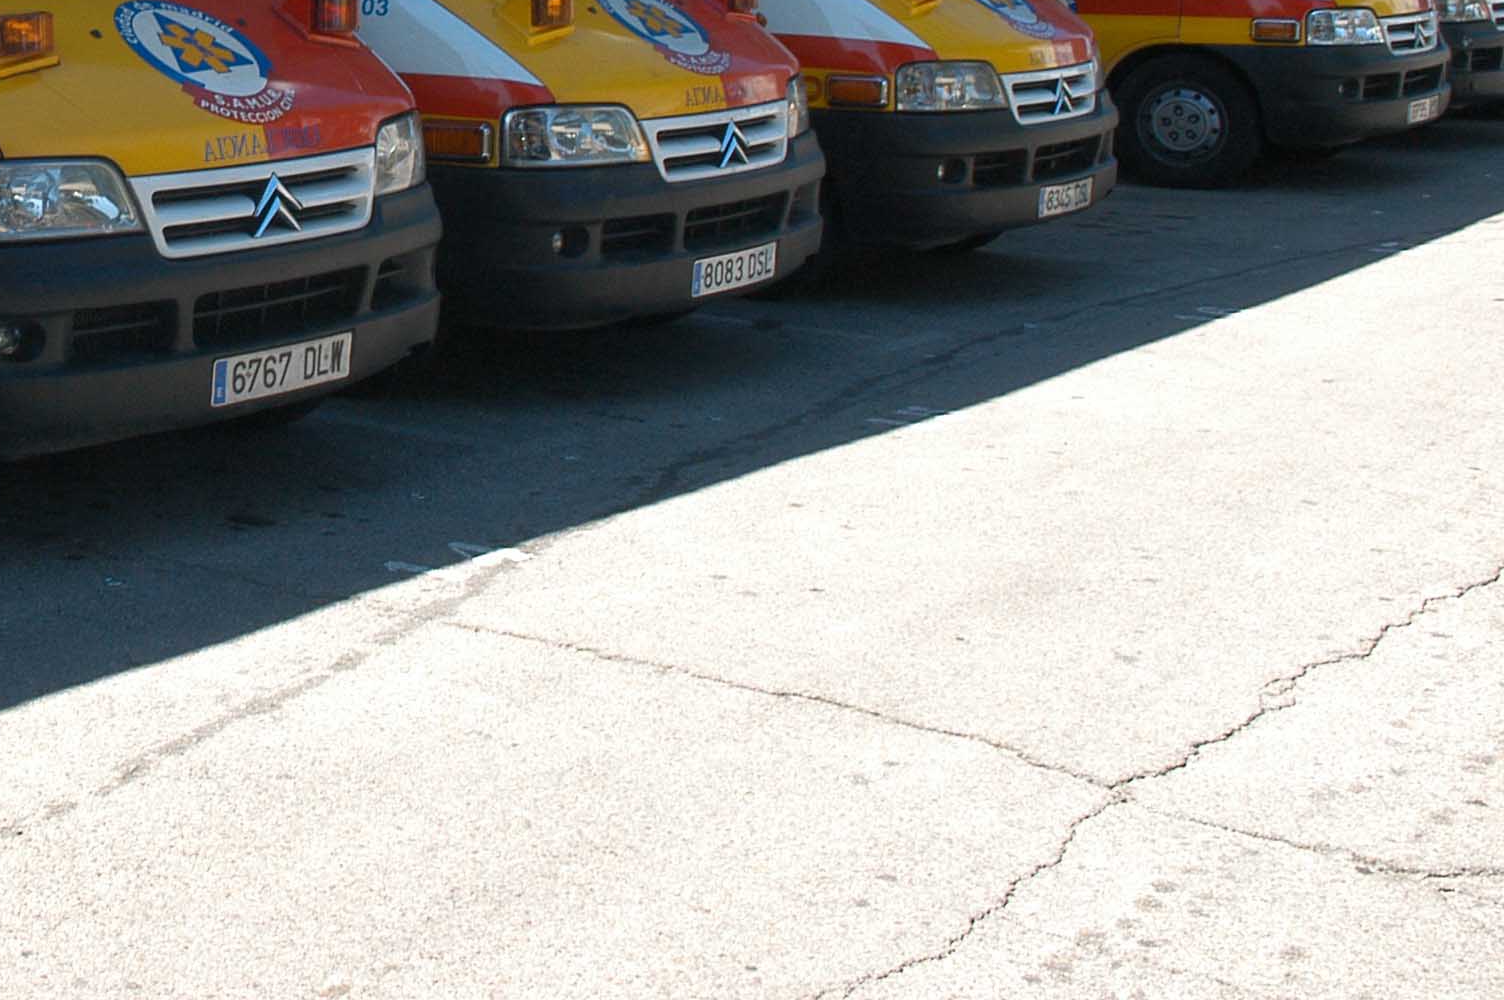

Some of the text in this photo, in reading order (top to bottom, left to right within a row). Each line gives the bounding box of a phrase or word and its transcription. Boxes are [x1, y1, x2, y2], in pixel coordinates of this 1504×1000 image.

[703, 256, 744, 288] 8083
[748, 247, 771, 279] DSL
[232, 340, 345, 394] 6767 DLW
